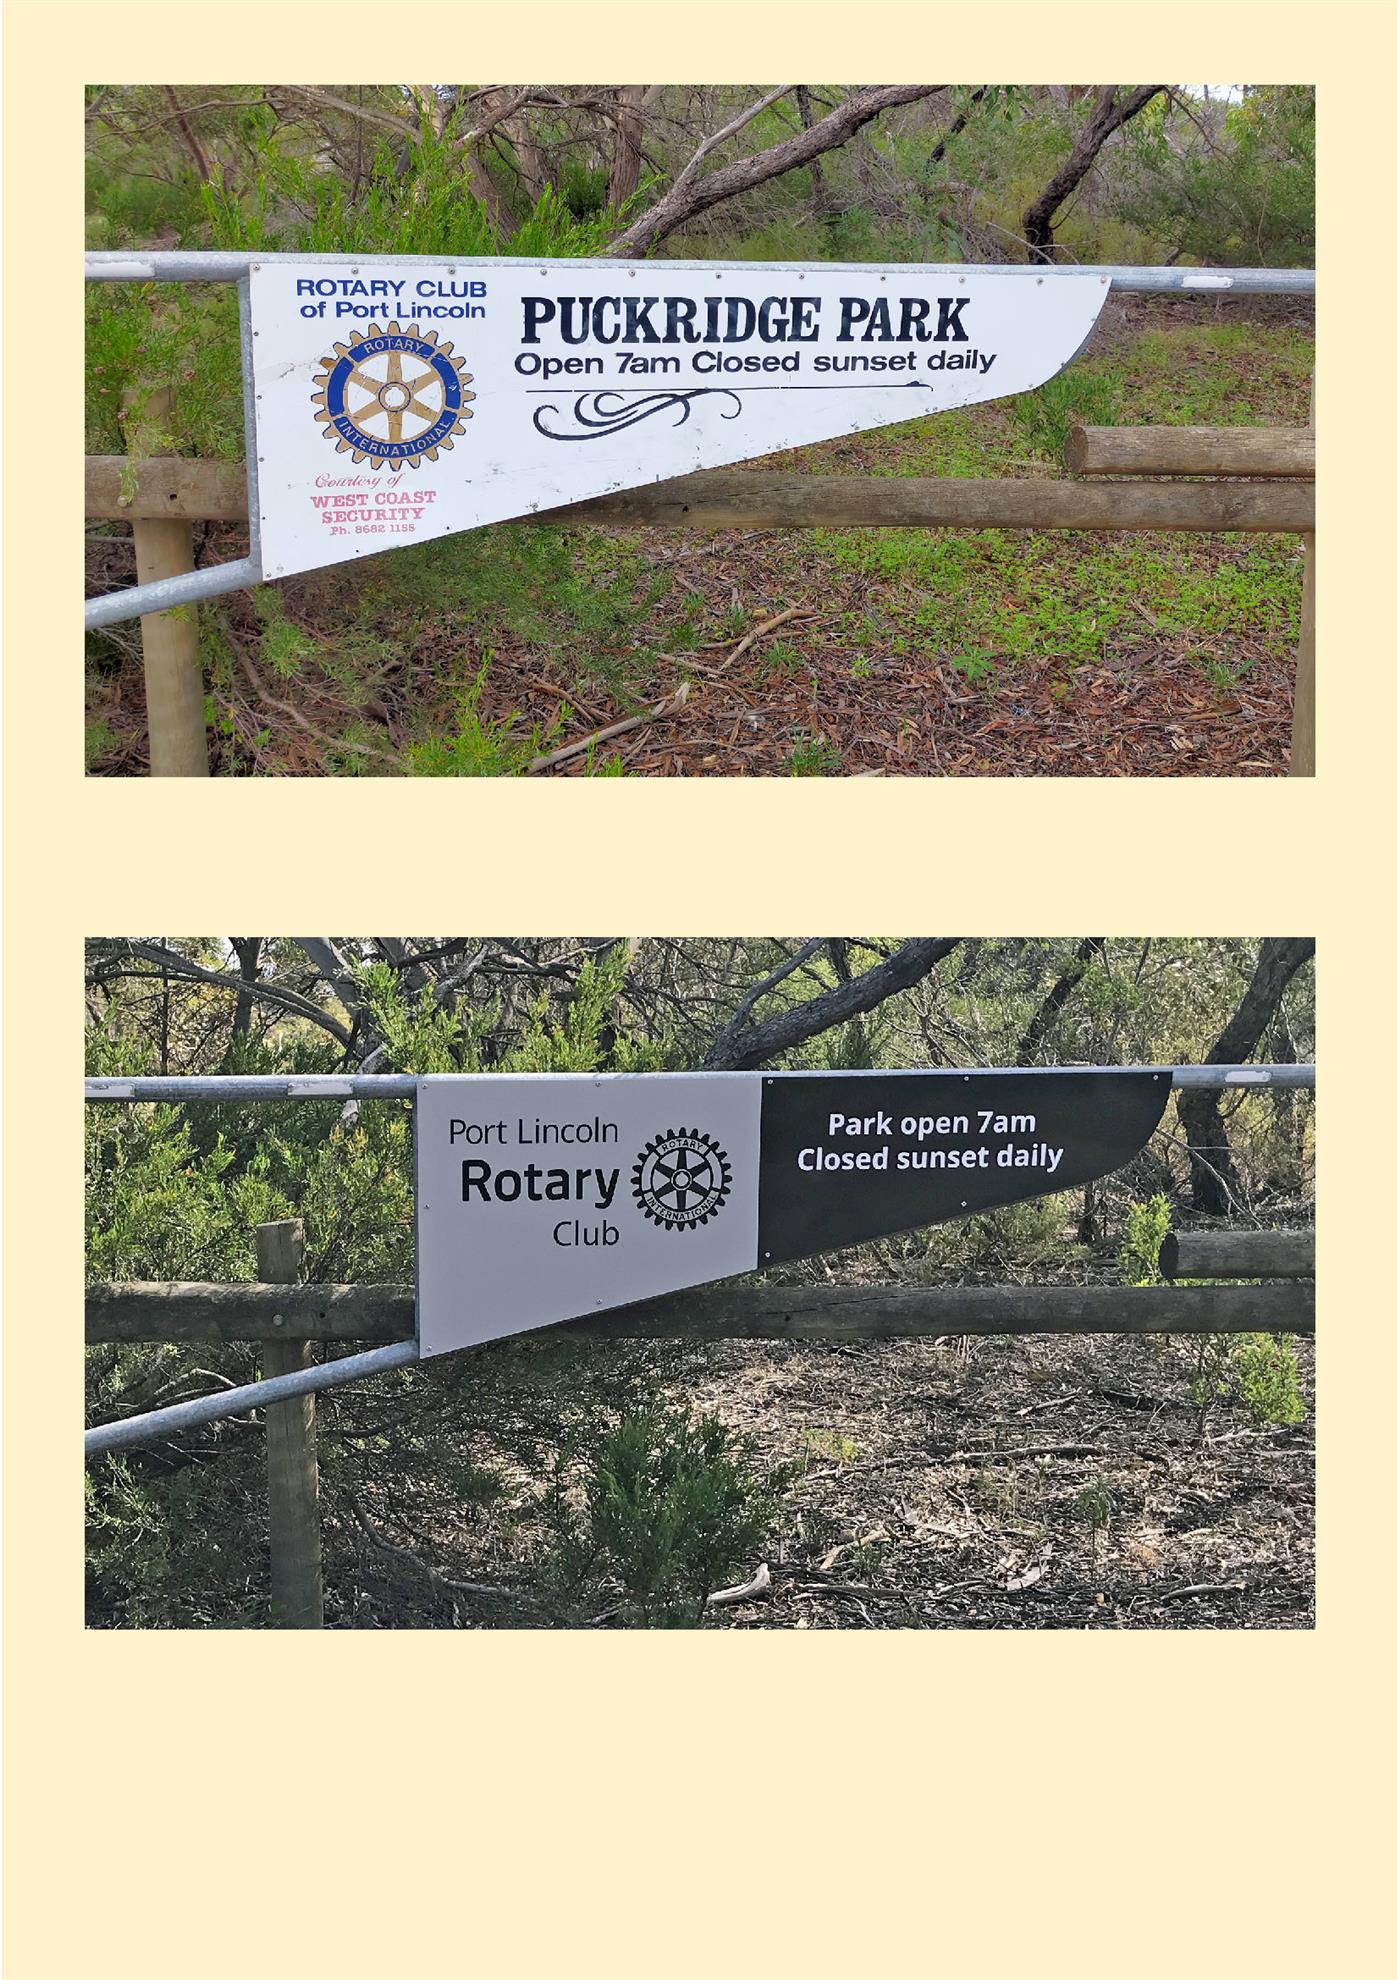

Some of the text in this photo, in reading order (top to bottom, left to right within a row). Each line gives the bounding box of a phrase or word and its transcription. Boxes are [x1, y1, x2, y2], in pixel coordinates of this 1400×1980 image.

[297, 279, 487, 297] ROTARY CLUB
[301, 302, 485, 319] of Port Lincoln
[521, 297, 970, 343] PUCKRIDGE PARK
[364, 338, 424, 355] ROTARY
[515, 350, 997, 379] Open 7am Closed sunset daily
[339, 418, 453, 456] INTERNATIONAL
[388, 473, 405, 487] of
[310, 491, 437, 508] WEST COAST
[322, 508, 425, 524] SECURITY
[330, 526, 351, 536] Ph.
[355, 525, 386, 534] 8682
[450, 1117, 618, 1144] Port Lincoln
[829, 1111, 1036, 1140] Park open 7am
[661, 1139, 703, 1152] ROTARY
[798, 1143, 1064, 1172] Closed sunset daily
[462, 1160, 620, 1209] Rotary
[646, 1192, 718, 1221] INTERNATIONAL
[553, 1220, 619, 1246] Club
